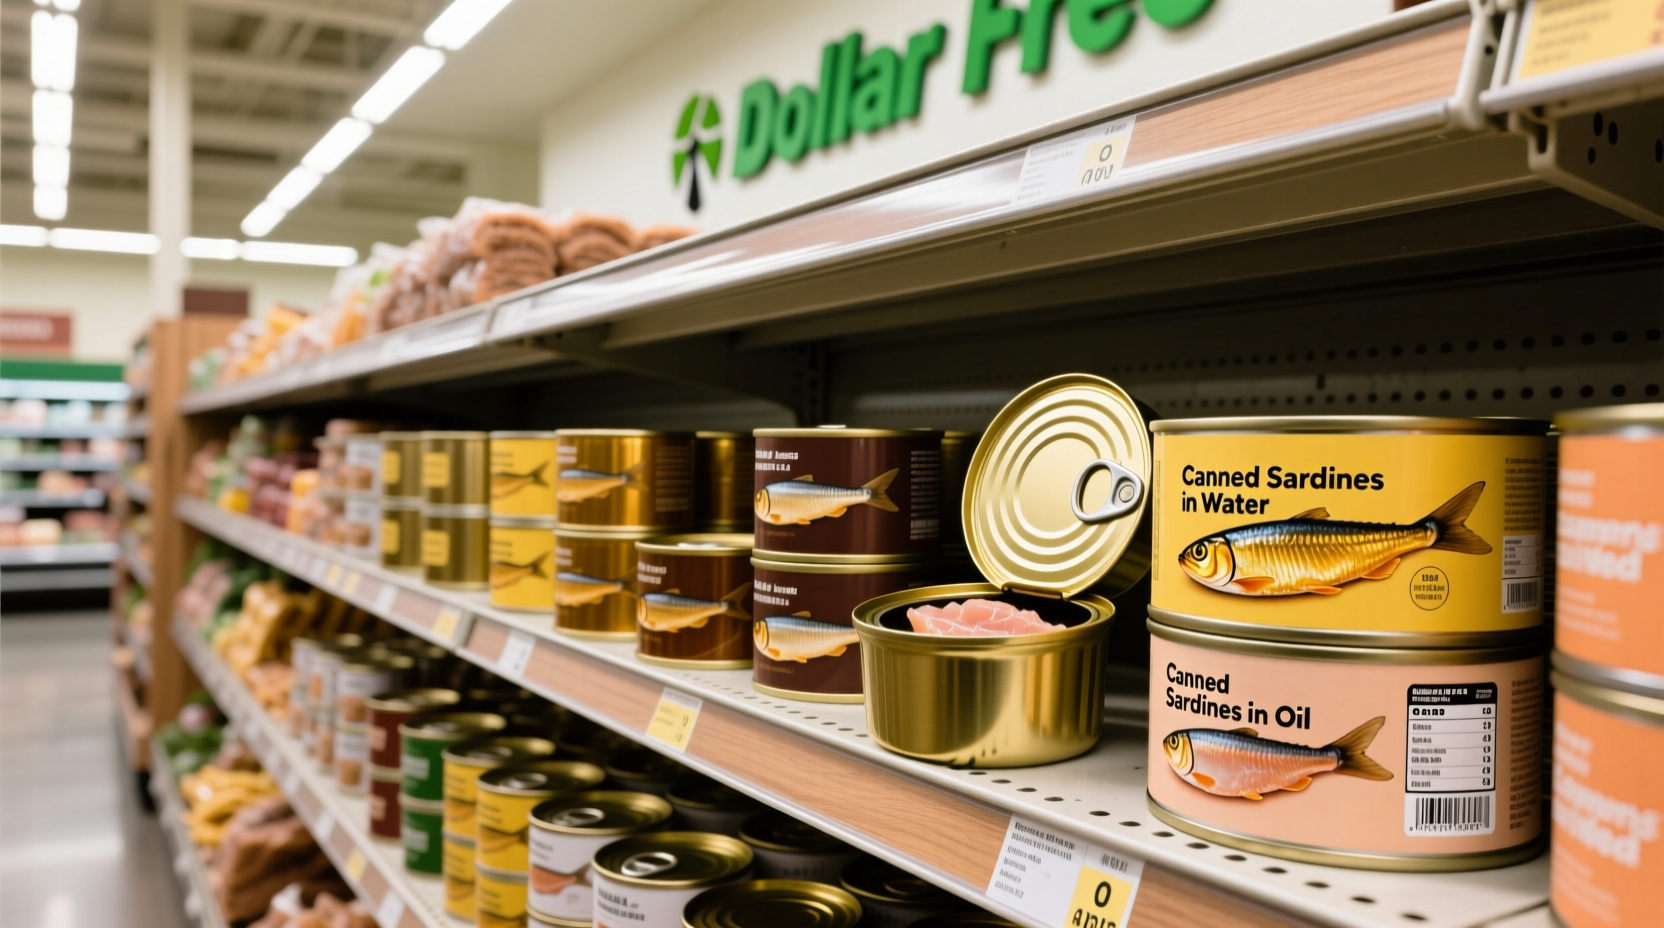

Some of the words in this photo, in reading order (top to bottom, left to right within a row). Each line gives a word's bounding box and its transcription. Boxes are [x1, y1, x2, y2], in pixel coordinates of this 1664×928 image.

[732, 22, 946, 179] Dollar
[1182, 464, 1260, 488] Canned
[1266, 465, 1385, 491] Sardines
[1182, 491, 1197, 513] in
[1201, 492, 1270, 515] Water
[1166, 662, 1230, 695] Canned
[1166, 686, 1242, 721] Sardines
[1248, 701, 1268, 725] in
[1275, 705, 1311, 730] Oil
